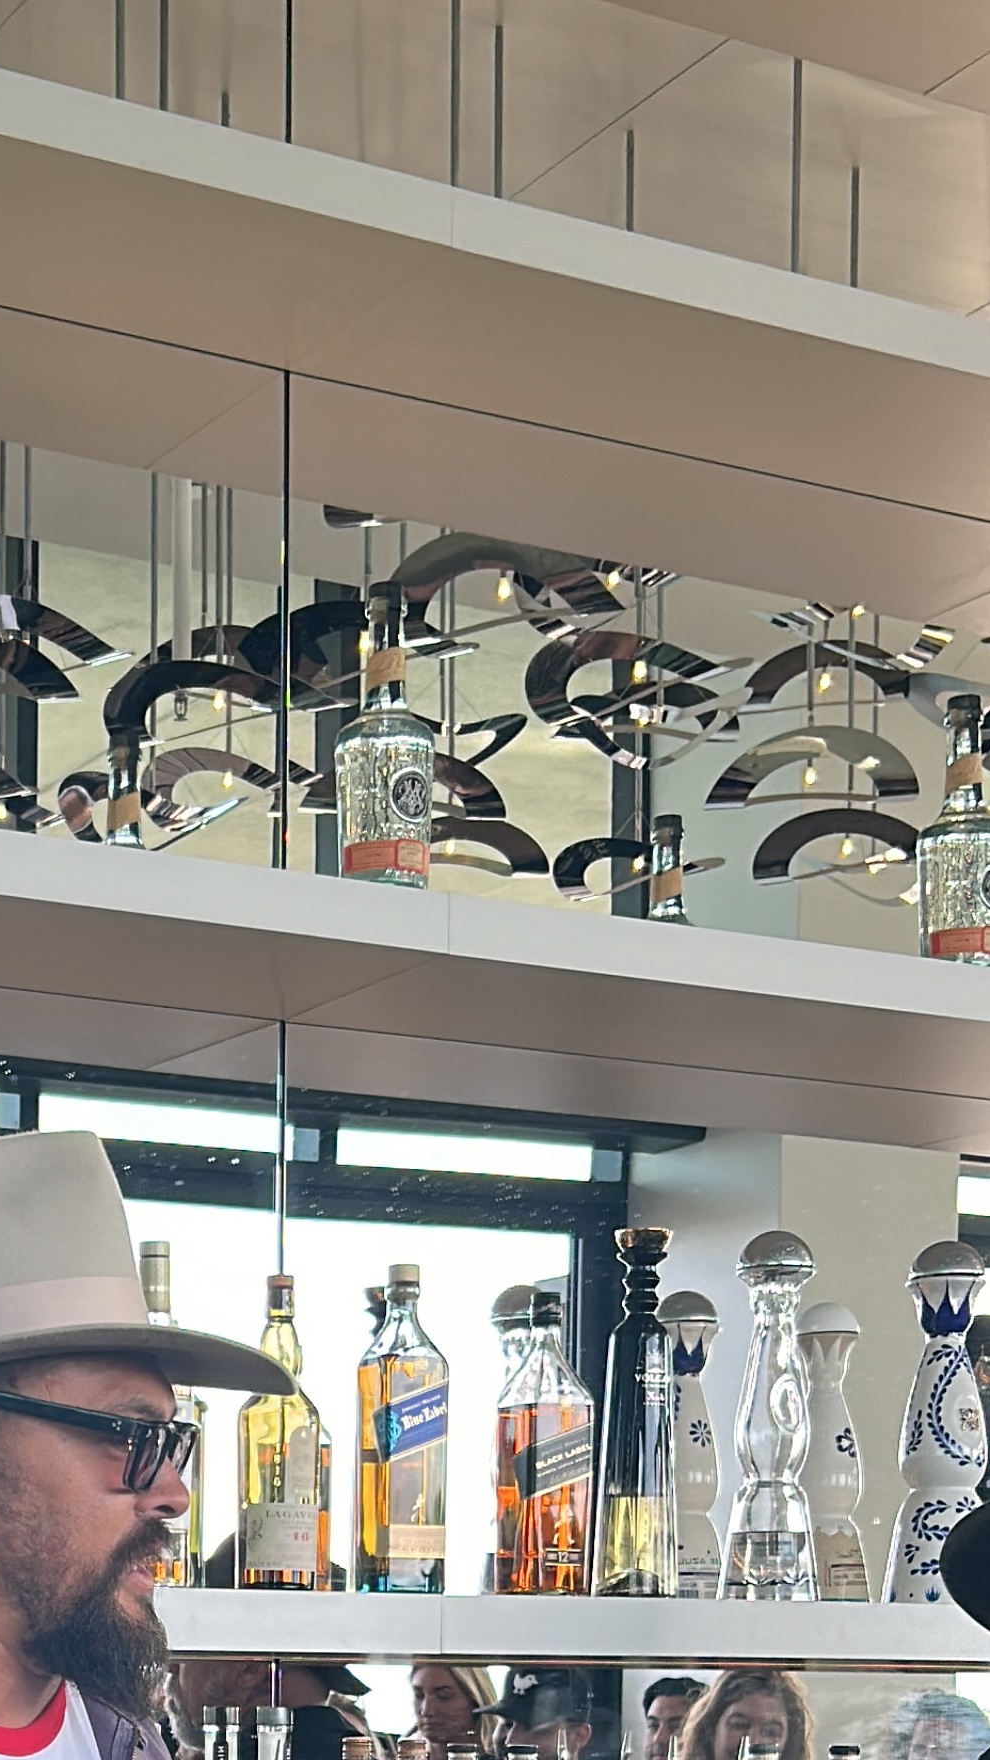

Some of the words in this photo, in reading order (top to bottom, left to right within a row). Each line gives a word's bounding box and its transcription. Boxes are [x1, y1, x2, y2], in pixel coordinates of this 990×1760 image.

[535, 1452, 563, 1470] BLACK
[564, 1443, 593, 1459] LABEL
[558, 1552, 570, 1563] 12
